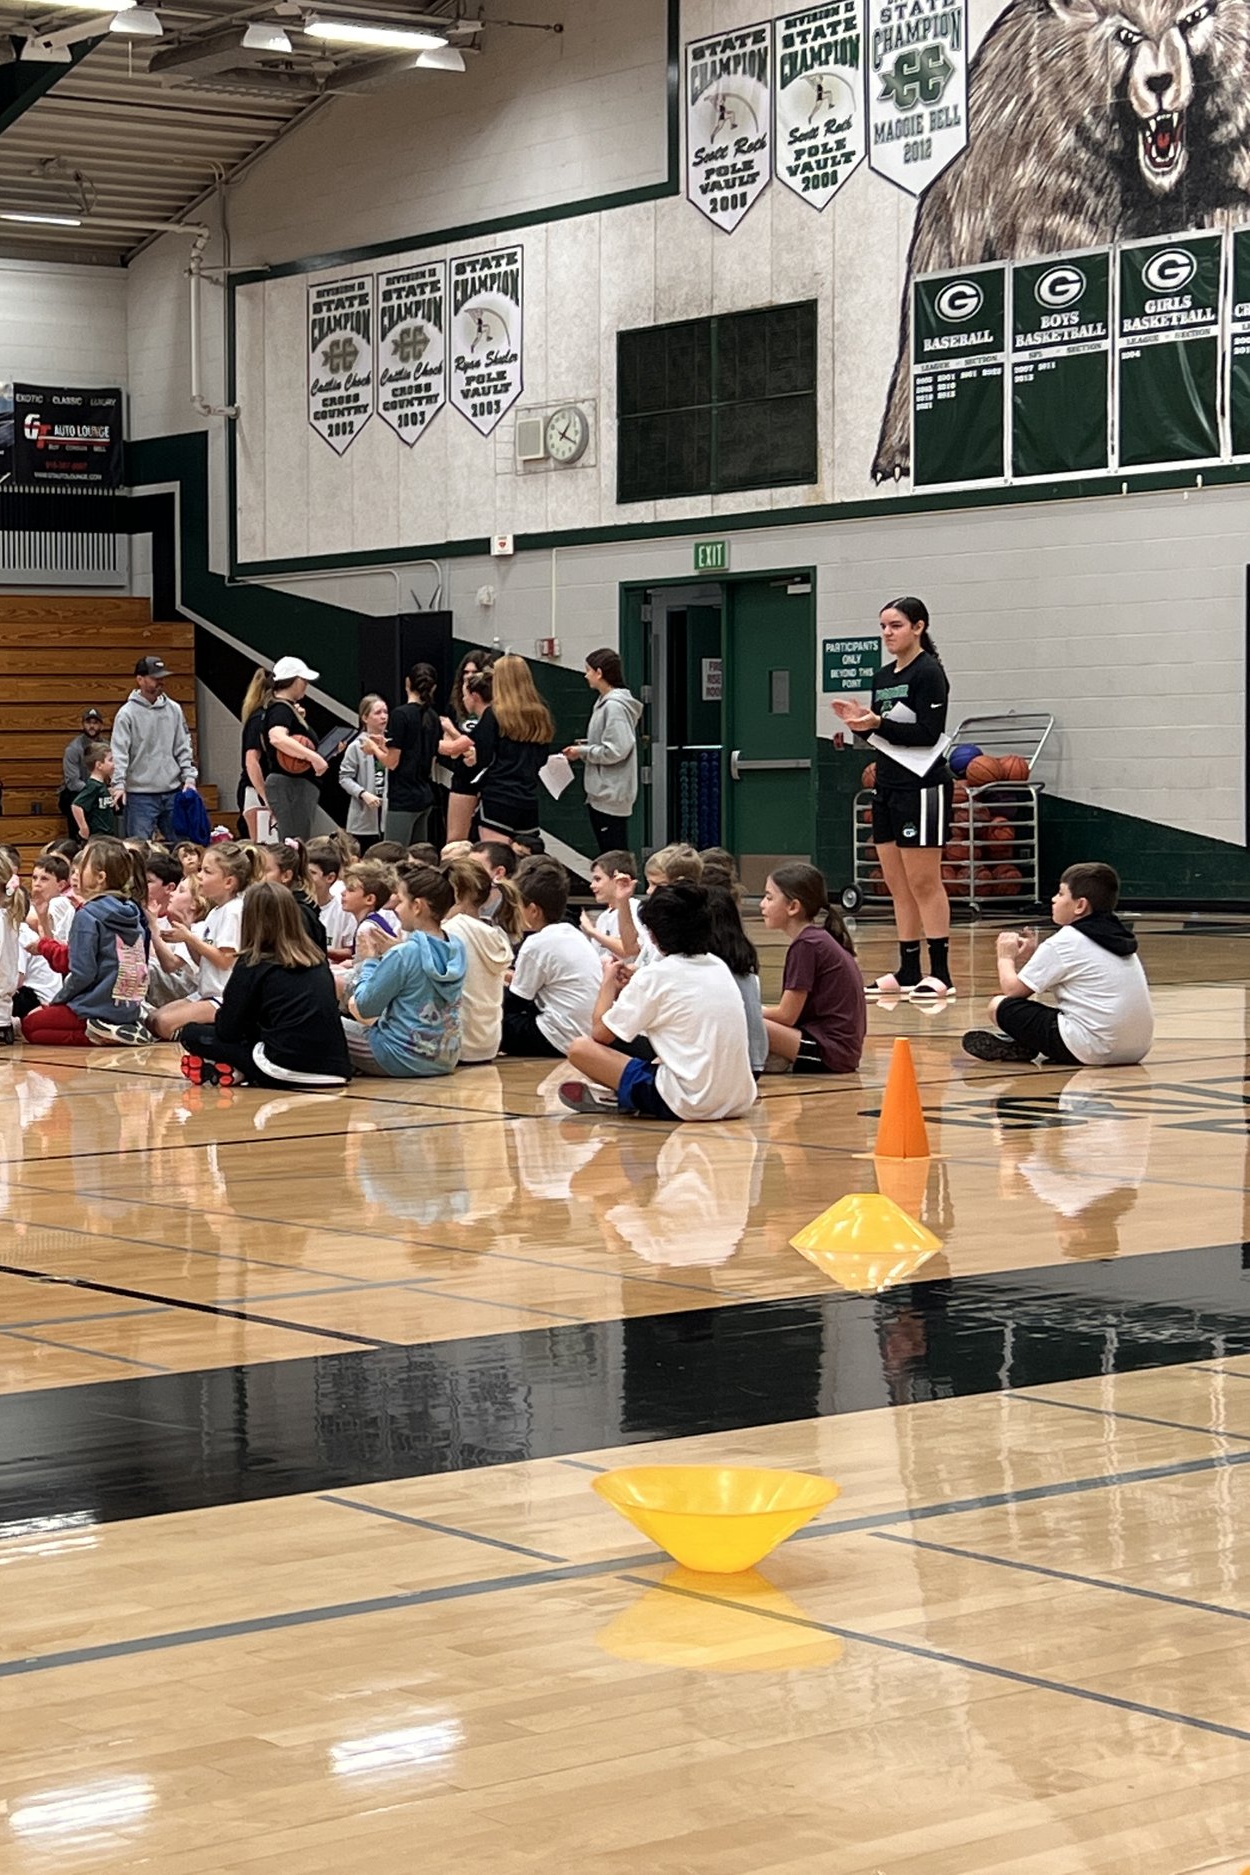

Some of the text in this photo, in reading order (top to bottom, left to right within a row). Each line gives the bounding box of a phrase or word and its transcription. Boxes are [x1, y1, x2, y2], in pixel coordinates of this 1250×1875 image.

[784, 4, 841, 30] DIVISION
[781, 15, 857, 49] STATE
[872, 7, 962, 72] CHAMPION
[692, 28, 766, 61] STATE
[780, 33, 860, 90] CHAMPION
[690, 46, 768, 106] CHAMPION
[787, 126, 819, 146] Scott
[873, 104, 961, 145] MAGGIE BELL
[692, 132, 767, 167] Scott Roth
[794, 138, 846, 162] POLE
[903, 137, 932, 164] 2012
[705, 159, 754, 180] POLE
[786, 150, 856, 177] VAULT
[699, 171, 760, 195] VAULT
[454, 251, 518, 276] STATE
[381, 279, 441, 303] STATE
[453, 267, 519, 317] CHAMPION
[312, 292, 369, 315] STATE
[1144, 295, 1192, 314] GIRLS
[380, 295, 442, 343] CHAMPION
[1040, 311, 1080, 329] BOYS
[1122, 308, 1216, 332] BASKETBALL
[311, 308, 371, 354] CHAMPION
[923, 329, 994, 352] BASEBALL
[1014, 322, 1106, 347] BASKETBALL
[1175, 328, 1210, 339] SECTION
[391, 382, 432, 398] CROSS
[465, 370, 507, 387] POLE
[15, 393, 44, 404] EXOTIC
[52, 396, 83, 406] CLASSIC
[322, 393, 360, 408] CROSS
[382, 393, 440, 411] COUNTRY
[460, 382, 512, 399] VAULT
[313, 403, 369, 421] COUNTRY
[54, 425, 110, 438] AUTO LOUNGE
[698, 544, 723, 567] EXIT
[825, 641, 878, 652] PARTICIPANTS
[841, 654, 862, 665] ONLY
[830, 667, 874, 679] BEYOND THIS
[841, 679, 862, 688] POINT
